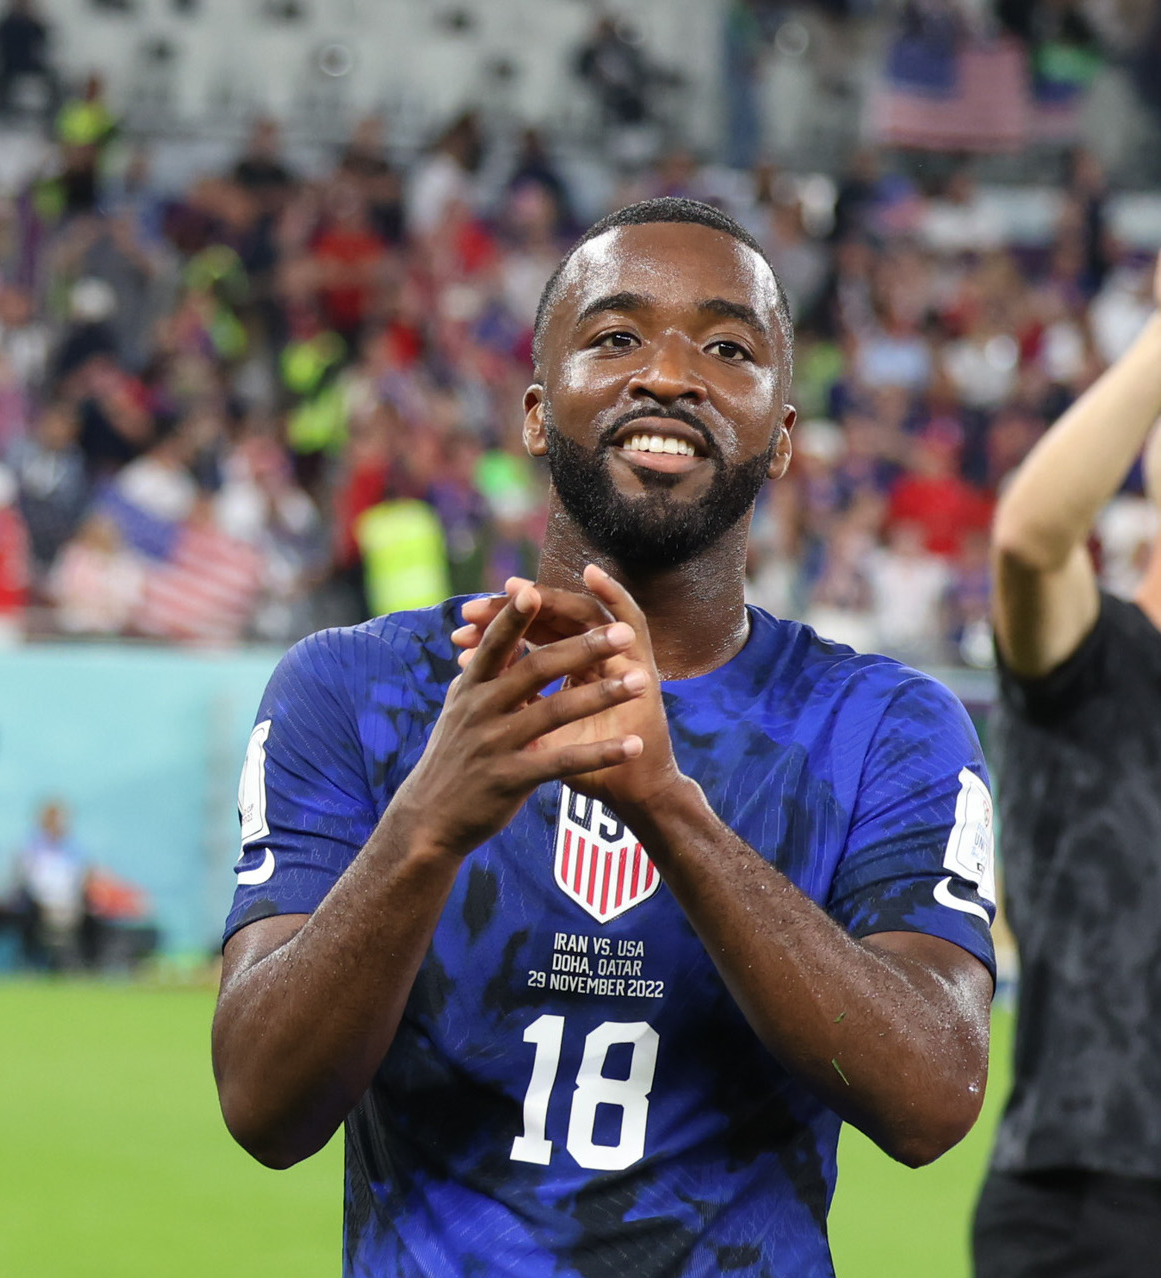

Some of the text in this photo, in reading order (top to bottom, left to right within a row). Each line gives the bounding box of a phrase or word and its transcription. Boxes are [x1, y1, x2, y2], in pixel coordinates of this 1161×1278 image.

[567, 786, 626, 844] US
[553, 932, 645, 957] IRAN VS. USA
[552, 953, 643, 977] DOHA, QATAR
[527, 970, 665, 998] 29 NOVEMBER 2022
[509, 1013, 661, 1171] 18
